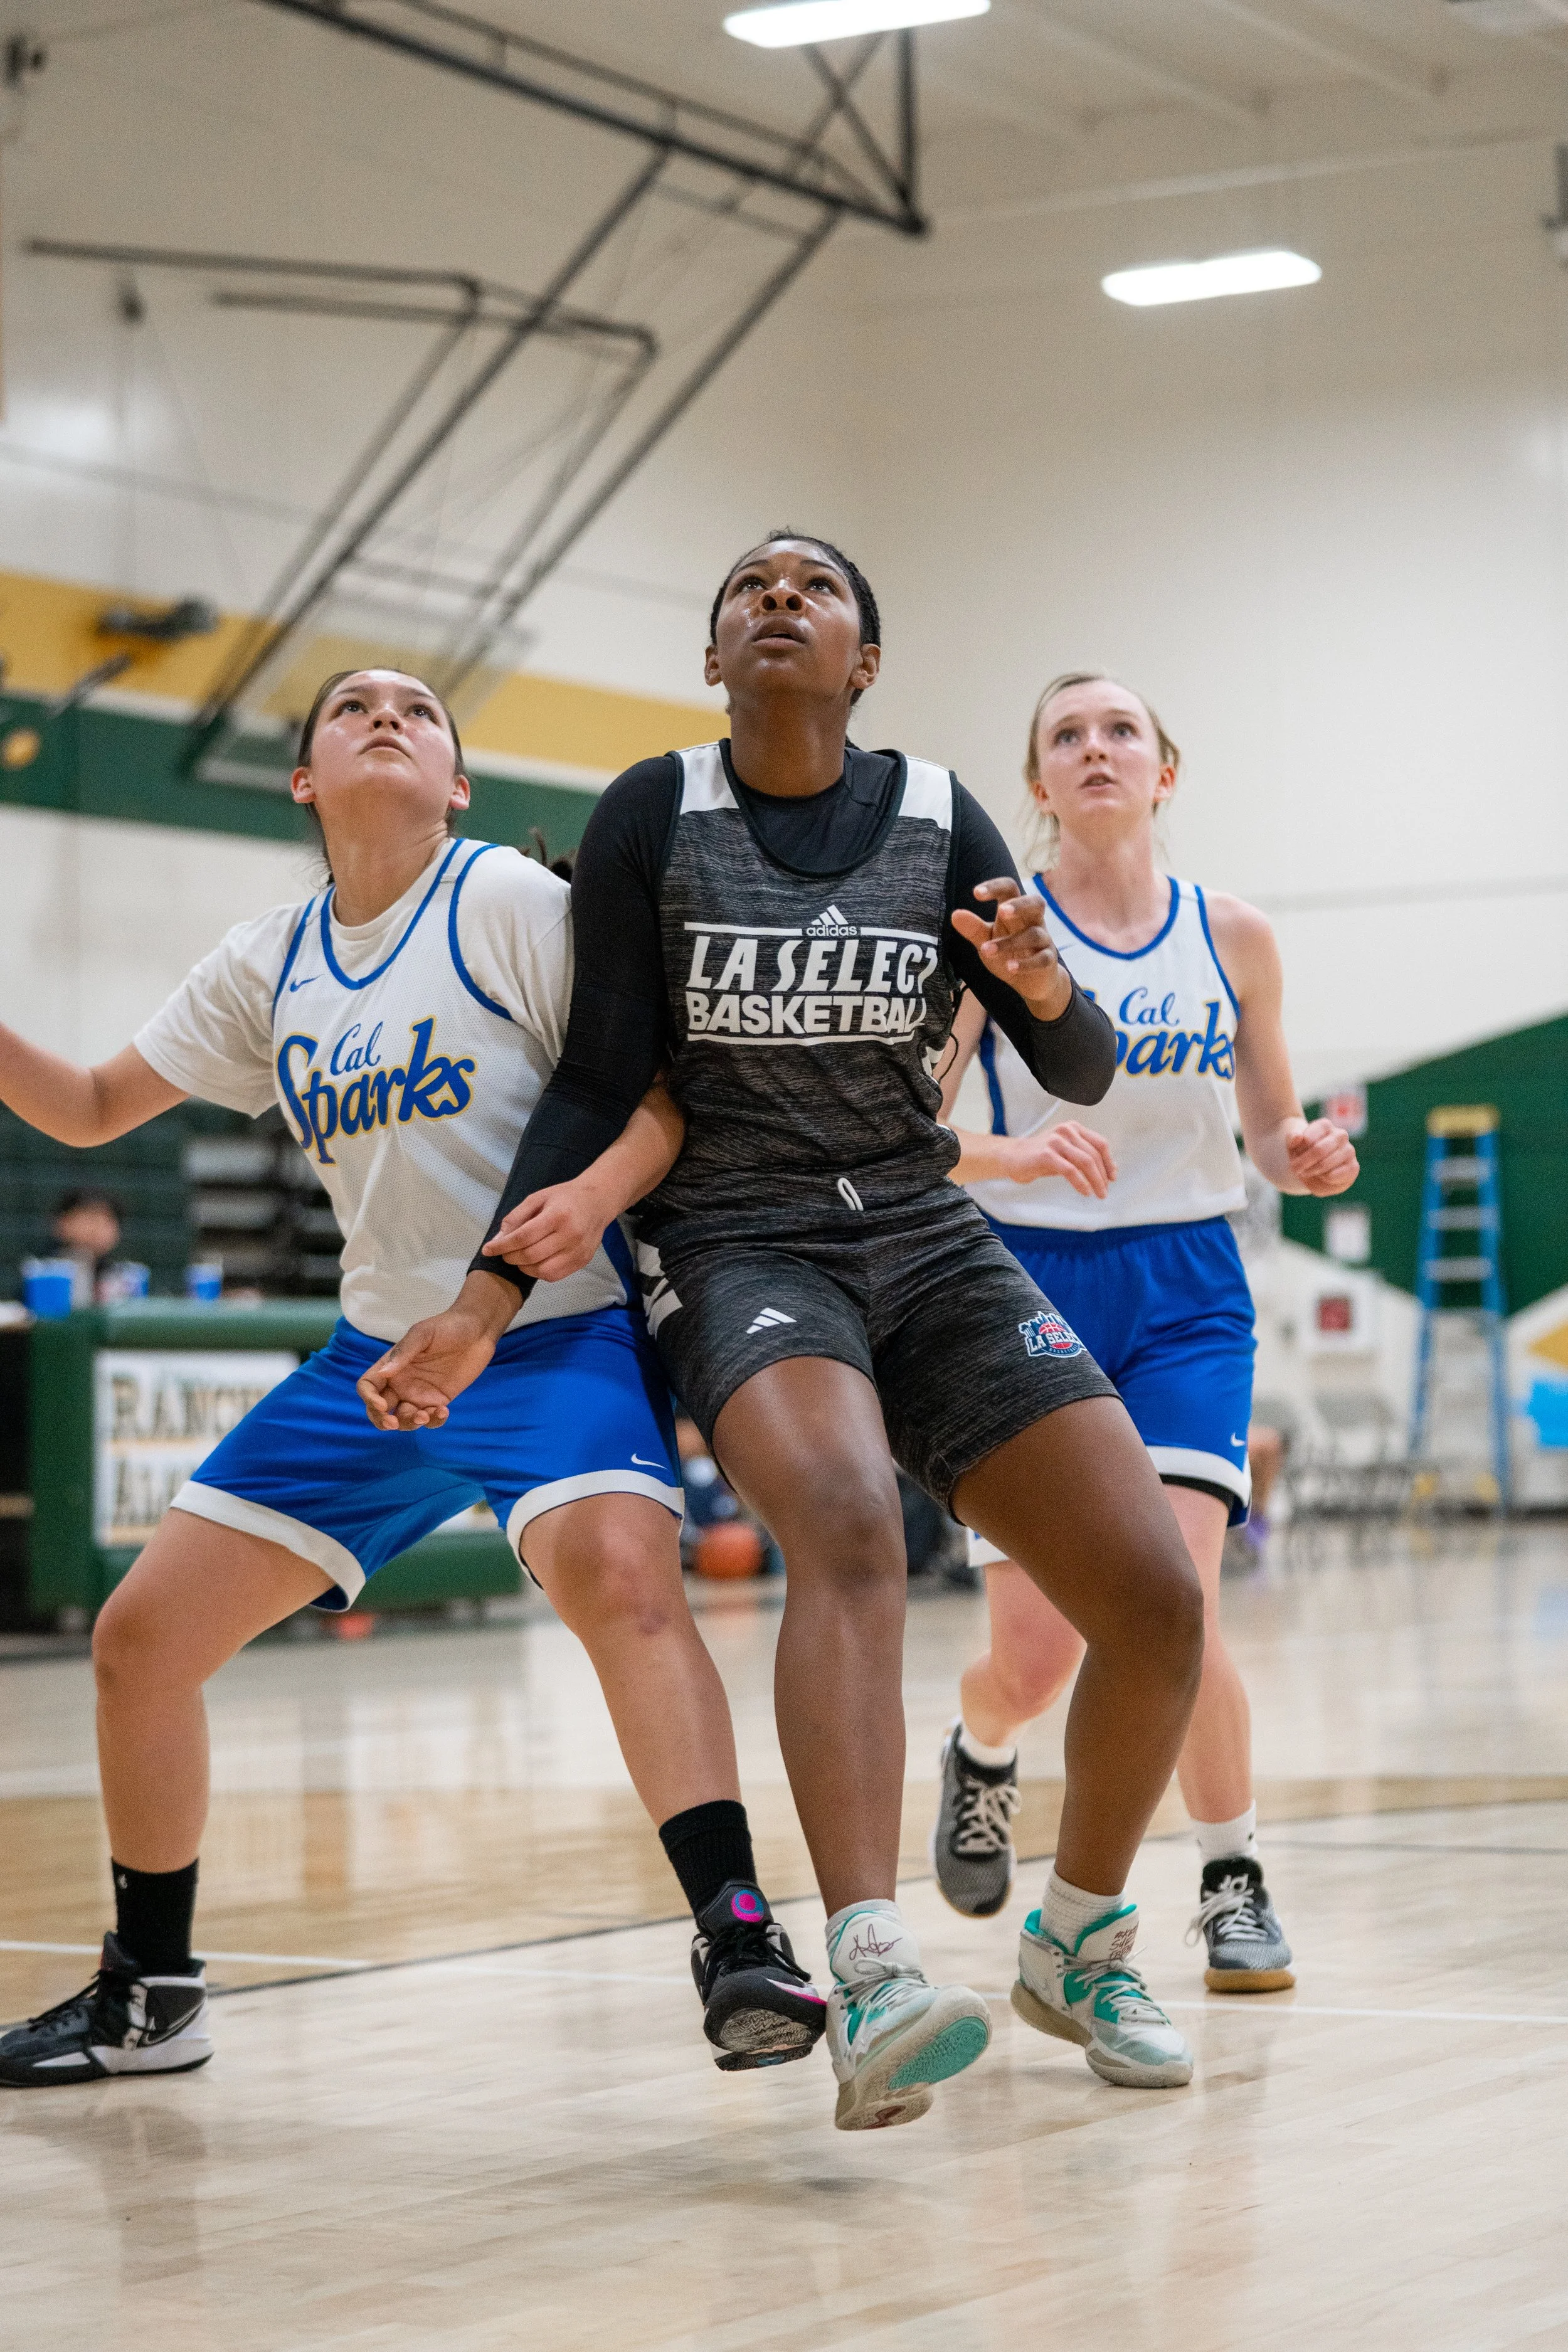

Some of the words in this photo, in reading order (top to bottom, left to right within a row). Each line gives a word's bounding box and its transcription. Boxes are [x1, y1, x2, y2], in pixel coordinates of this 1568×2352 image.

[806, 924, 857, 937] adidas
[686, 936, 758, 992] LA
[1119, 986, 1180, 1027] Cal
[330, 1020, 381, 1076] Cal
[276, 1014, 479, 1167] Sparks
